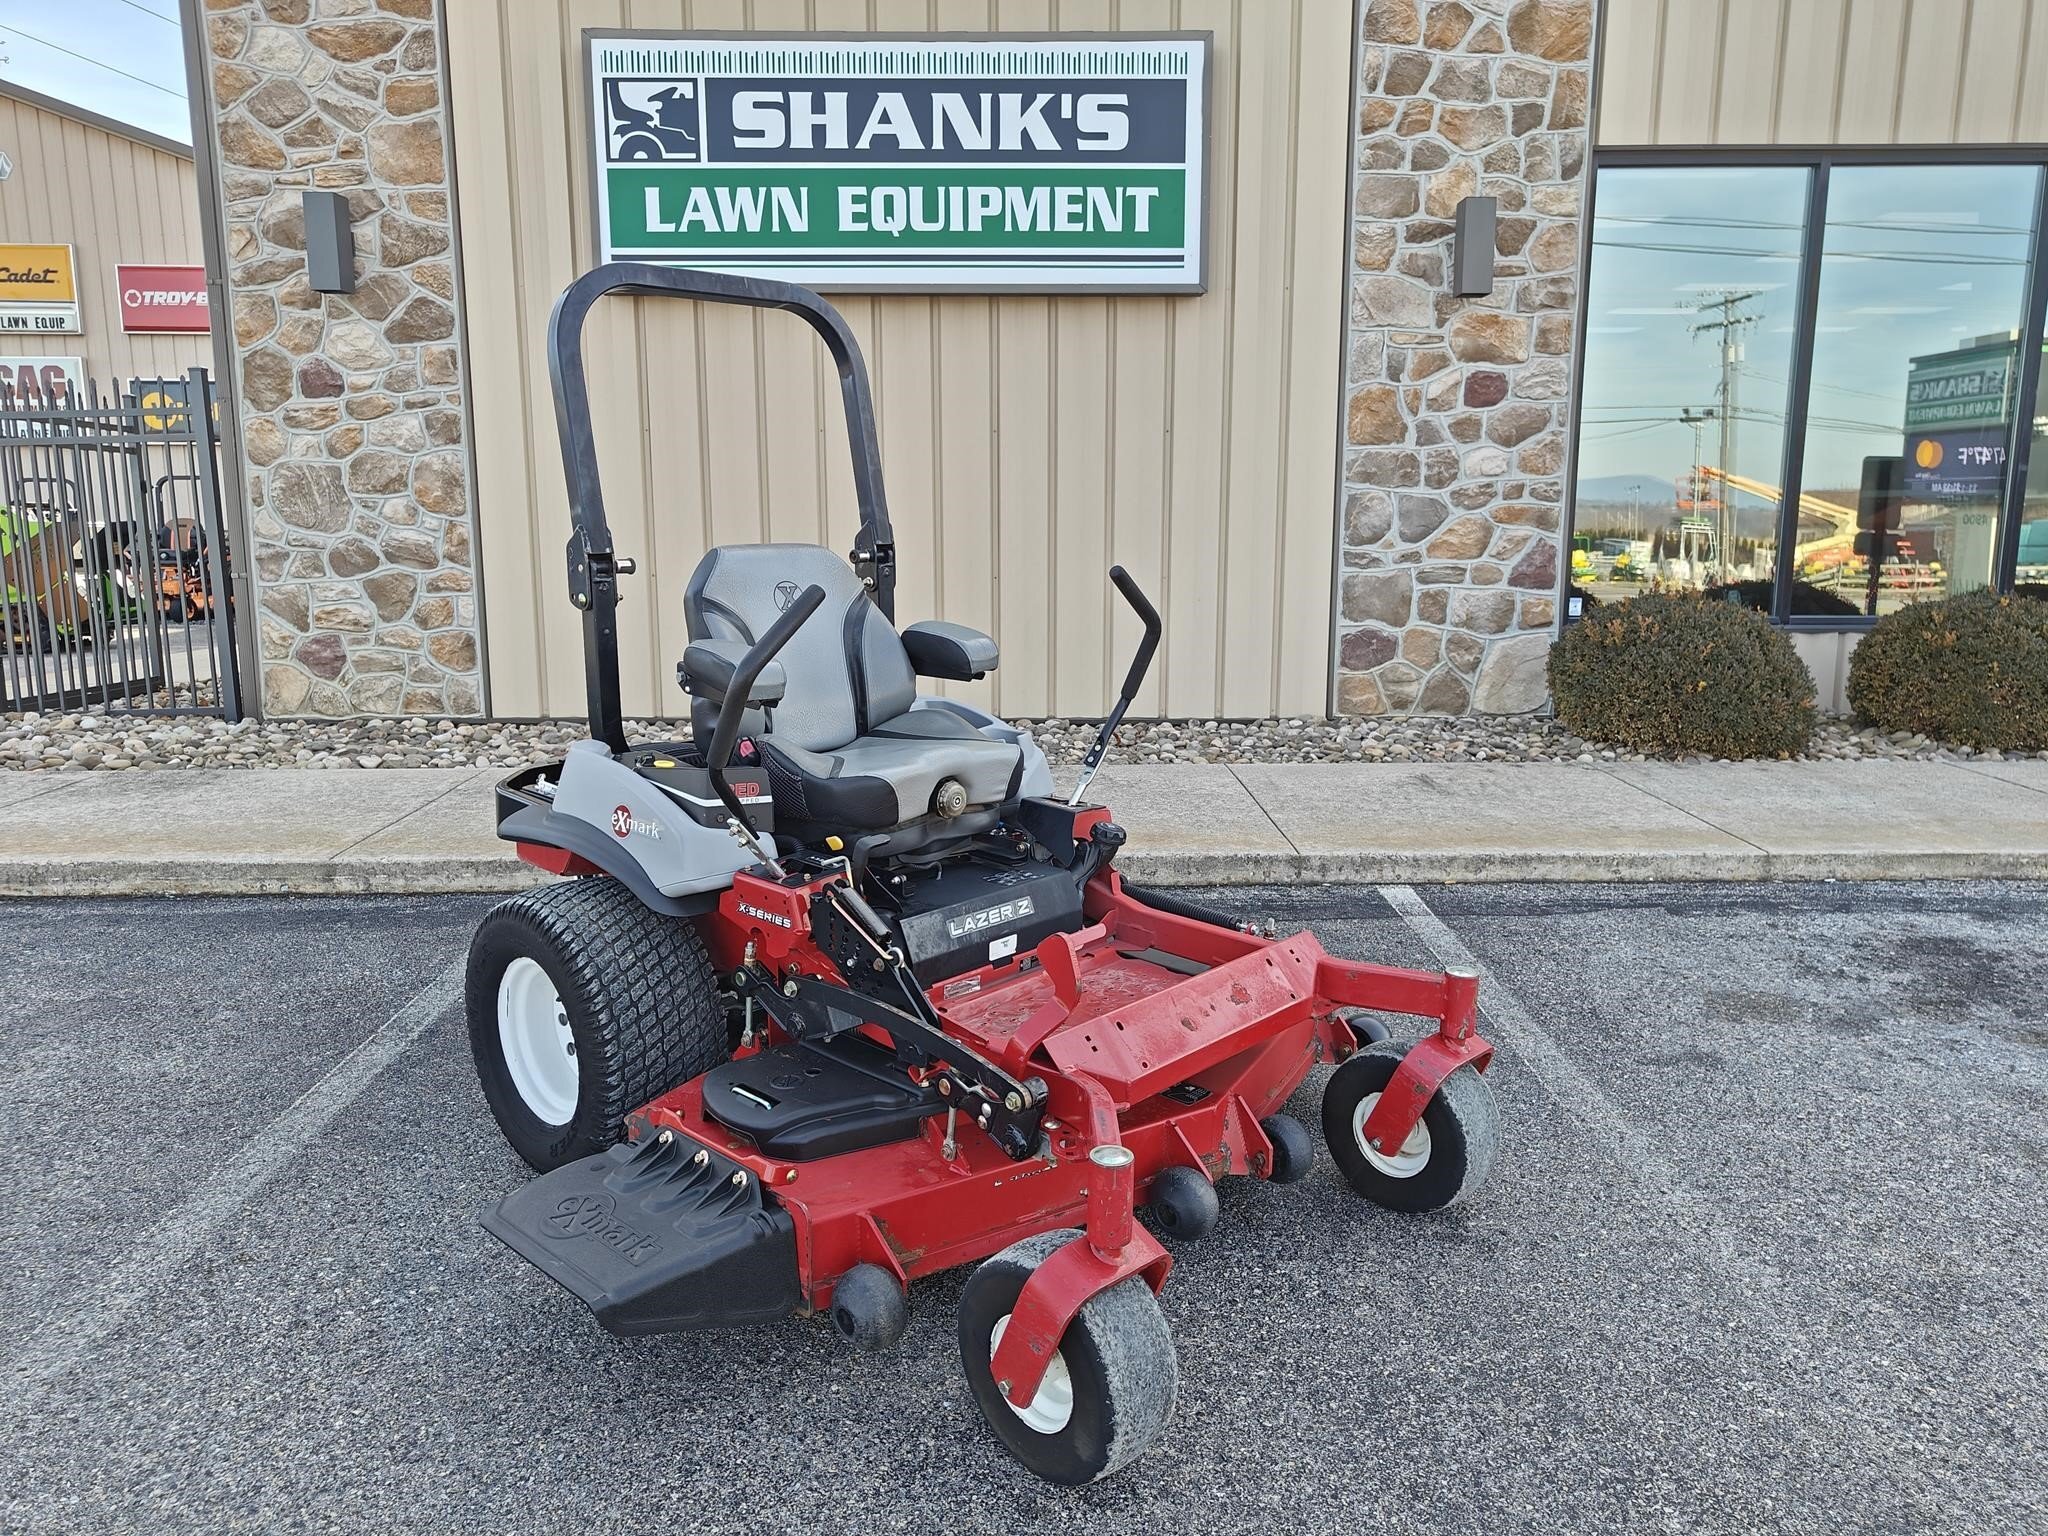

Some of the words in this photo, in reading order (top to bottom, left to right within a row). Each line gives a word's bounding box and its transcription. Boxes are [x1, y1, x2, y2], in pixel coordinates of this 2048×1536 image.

[731, 91, 1130, 151] SHANK'S
[644, 186, 808, 233] LAWN
[837, 186, 1159, 237] EQUIPMENT
[0, 316, 28, 329] LAWN
[739, 903, 791, 929] X-SERIES
[950, 906, 1014, 935] LAZER
[1017, 900, 1030, 914] Z
